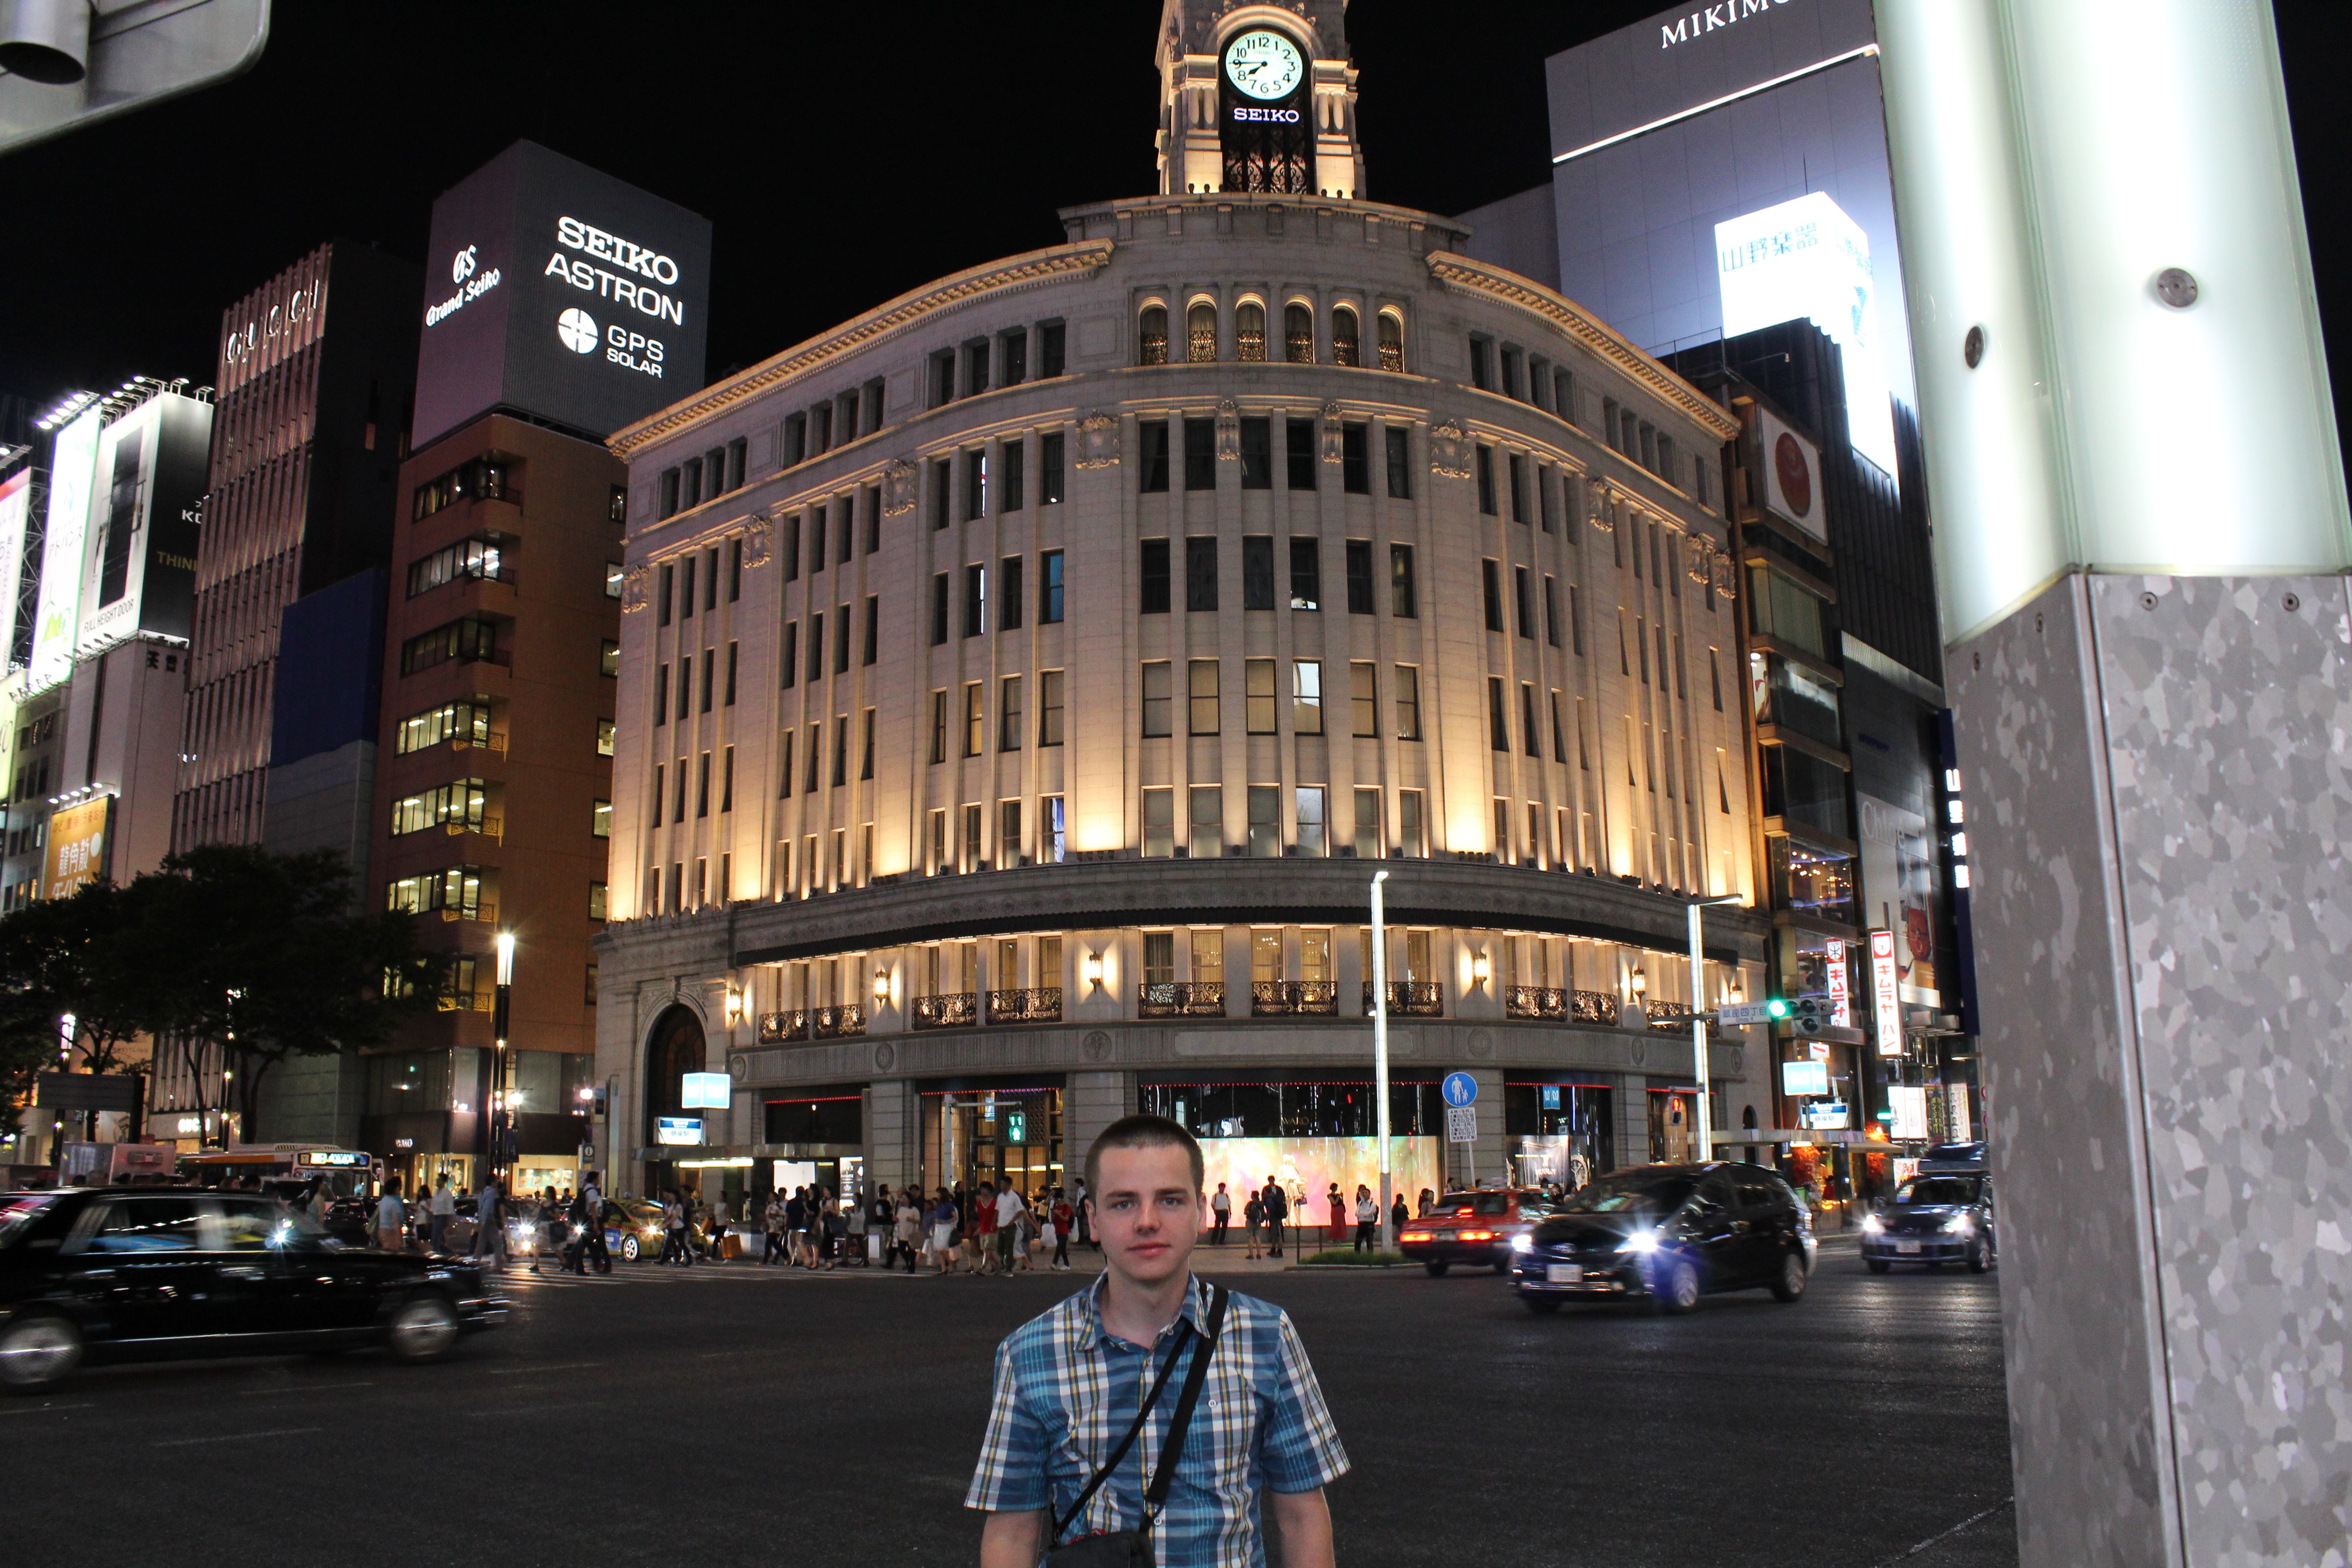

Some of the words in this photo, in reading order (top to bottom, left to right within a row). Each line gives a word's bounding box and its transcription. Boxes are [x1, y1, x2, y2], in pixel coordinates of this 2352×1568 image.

[1661, 0, 1791, 49] MIKIM
[1247, 39, 1255, 49] 11
[1259, 37, 1269, 47] 12
[1275, 41, 1279, 51] 1
[1237, 47, 1247, 58] 10
[1283, 49, 1291, 59] 2
[1233, 59, 1242, 69] 9
[1288, 61, 1295, 72] 3
[1238, 70, 1246, 81] 8
[1283, 73, 1292, 83] 4
[1249, 79, 1257, 90] 7
[1260, 83, 1269, 93] 6
[1273, 80, 1281, 91] 5
[1234, 108, 1299, 123] SEIKO
[558, 216, 679, 285] SEIKO
[1722, 221, 1818, 272] 山野楽器
[453, 244, 477, 284] GS
[544, 252, 683, 326] ASTRON
[426, 288, 464, 327] Grand
[465, 267, 500, 302] Seiko
[608, 325, 664, 362] GPS
[606, 347, 662, 378] SOLAR
[83, 617, 96, 634] FULL
[97, 607, 118, 628] HEIGHT
[118, 598, 134, 617] DOOR
[1723, 1006, 1767, 1017] 銀座四丁目
[177, 1117, 211, 1133] GUCI
[1280, 1117, 1309, 1125] WAKO
